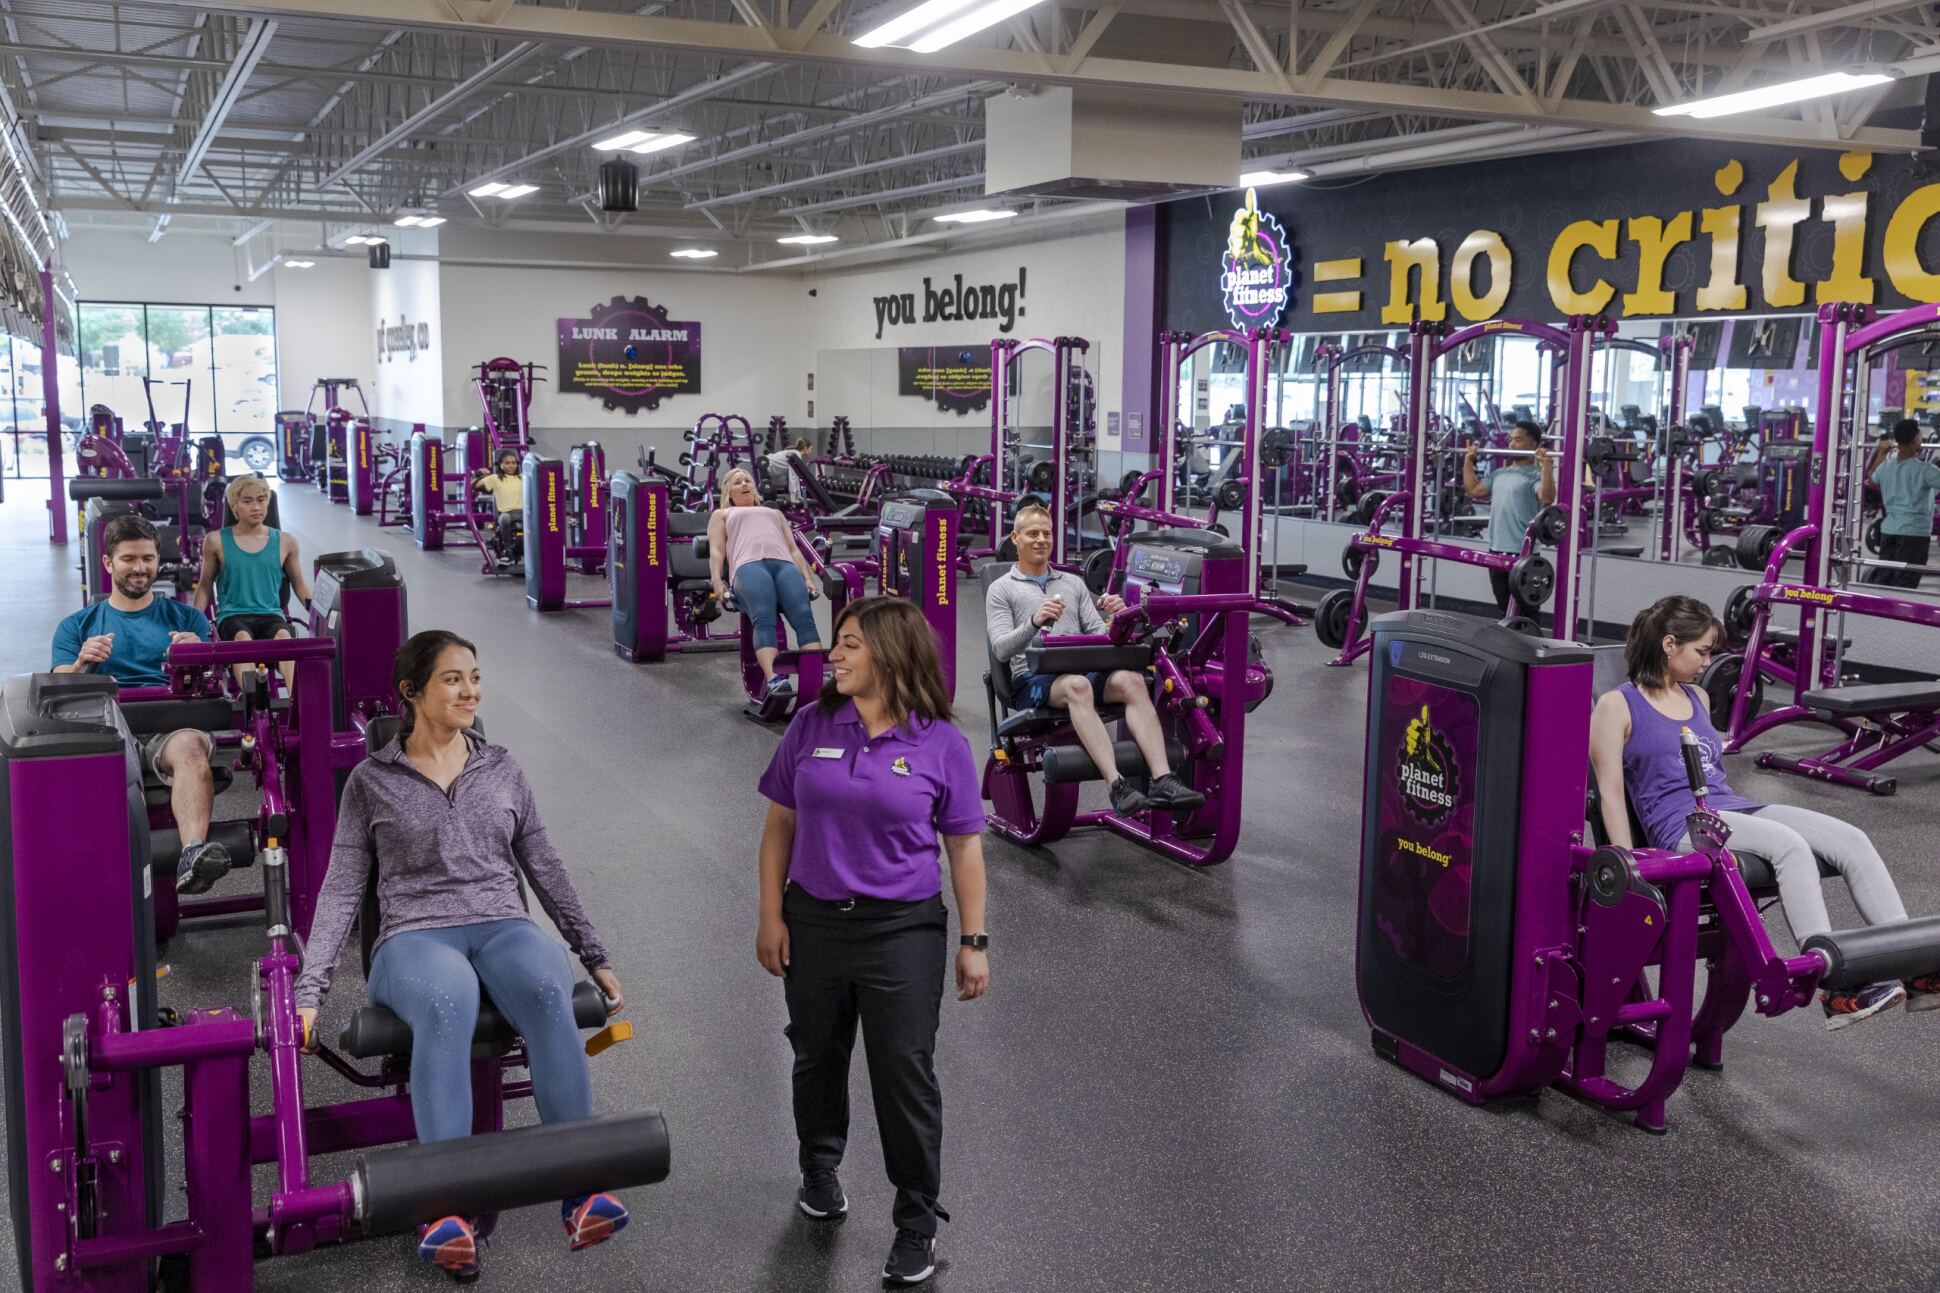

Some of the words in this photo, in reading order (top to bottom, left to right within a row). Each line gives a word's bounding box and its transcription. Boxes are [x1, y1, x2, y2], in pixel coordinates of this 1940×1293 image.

[1381, 229, 1512, 324] no
[1547, 152, 1940, 317] critic
[1226, 264, 1274, 292] planet
[873, 293, 916, 339] you
[923, 266, 1027, 333] belong!
[1233, 285, 1284, 305] fitness
[571, 327, 618, 340] LUNK
[629, 328, 688, 341] ALARM
[547, 471, 556, 501] fitness
[548, 503, 559, 532] planet
[647, 492, 656, 529] fitness
[647, 531, 659, 566] planet
[936, 517, 947, 562] fitness
[936, 564, 949, 605] planet
[1784, 587, 1799, 599] you
[1798, 588, 1834, 605] belong
[1400, 762, 1444, 789] planet
[1405, 779, 1452, 807] fitness
[1398, 838, 1415, 852] you
[1416, 842, 1450, 867] belong
